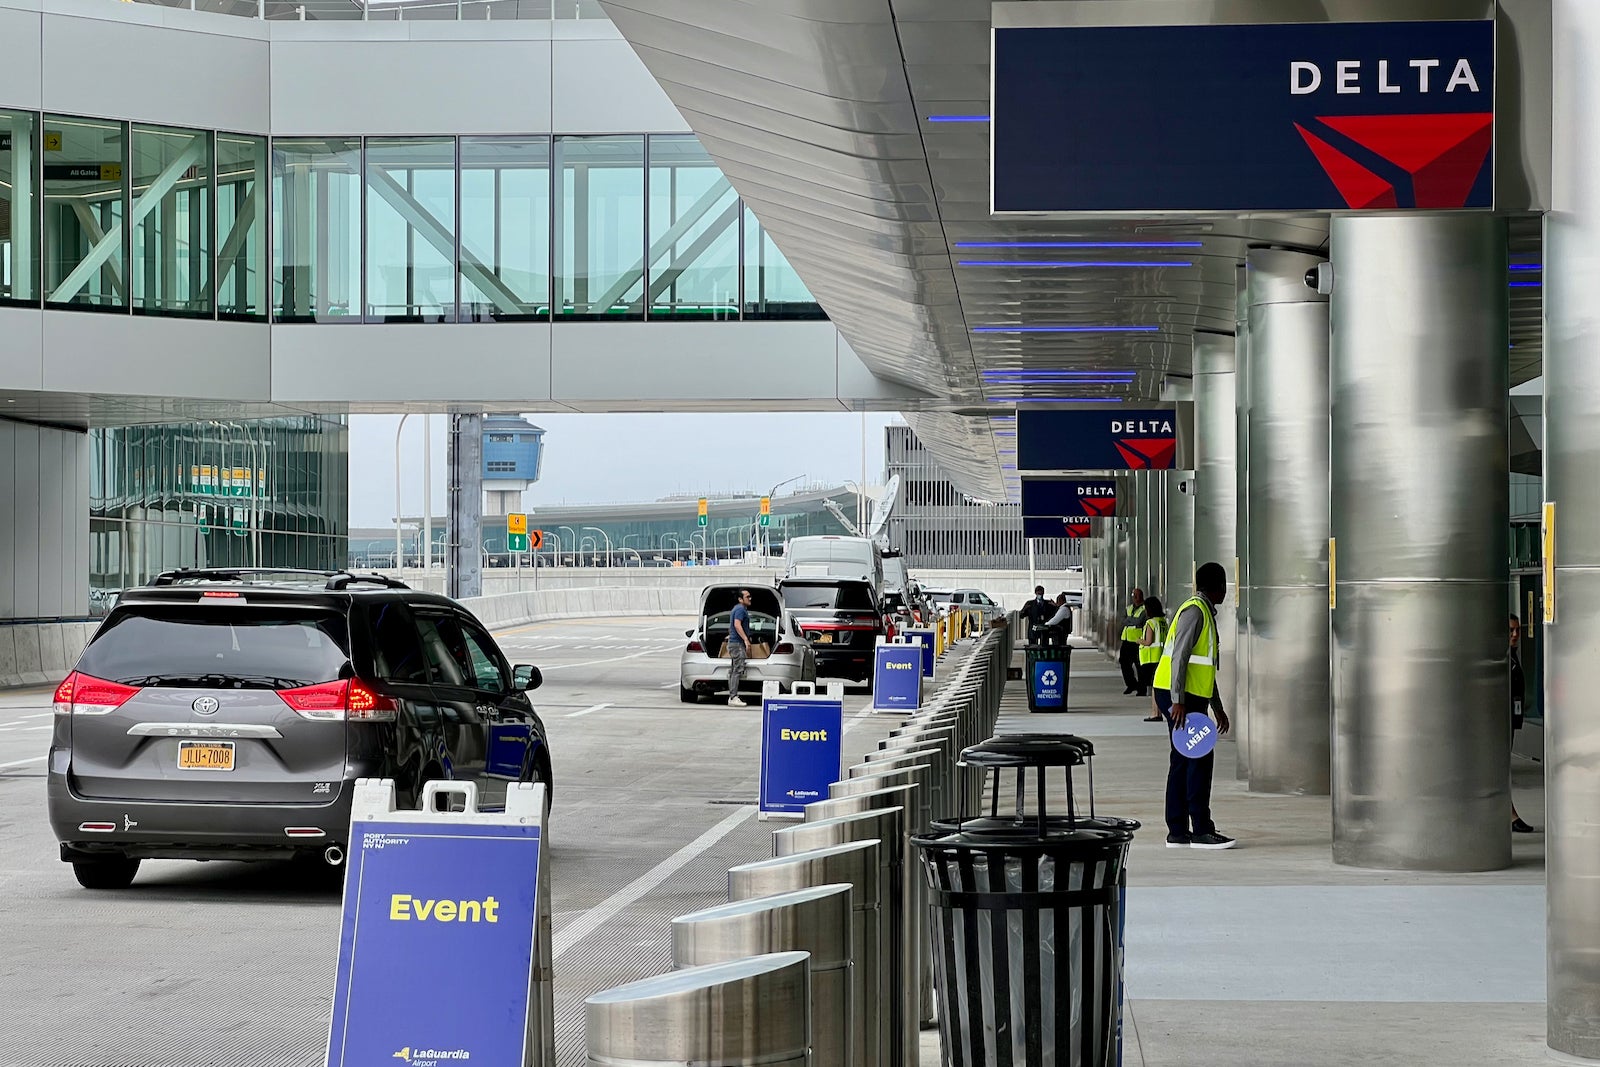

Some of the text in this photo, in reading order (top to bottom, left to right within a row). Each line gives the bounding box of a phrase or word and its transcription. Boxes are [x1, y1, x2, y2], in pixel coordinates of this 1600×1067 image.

[1289, 58, 1480, 95] DELTA
[1111, 420, 1172, 433] DELTA
[1077, 487, 1114, 496] DELTA
[885, 662, 912, 670] Event
[780, 728, 827, 742] Event
[1185, 725, 1211, 751] EVENT
[207, 749, 230, 764] 7008
[389, 893, 500, 923] Event
[412, 1049, 470, 1059] LaGuardia
